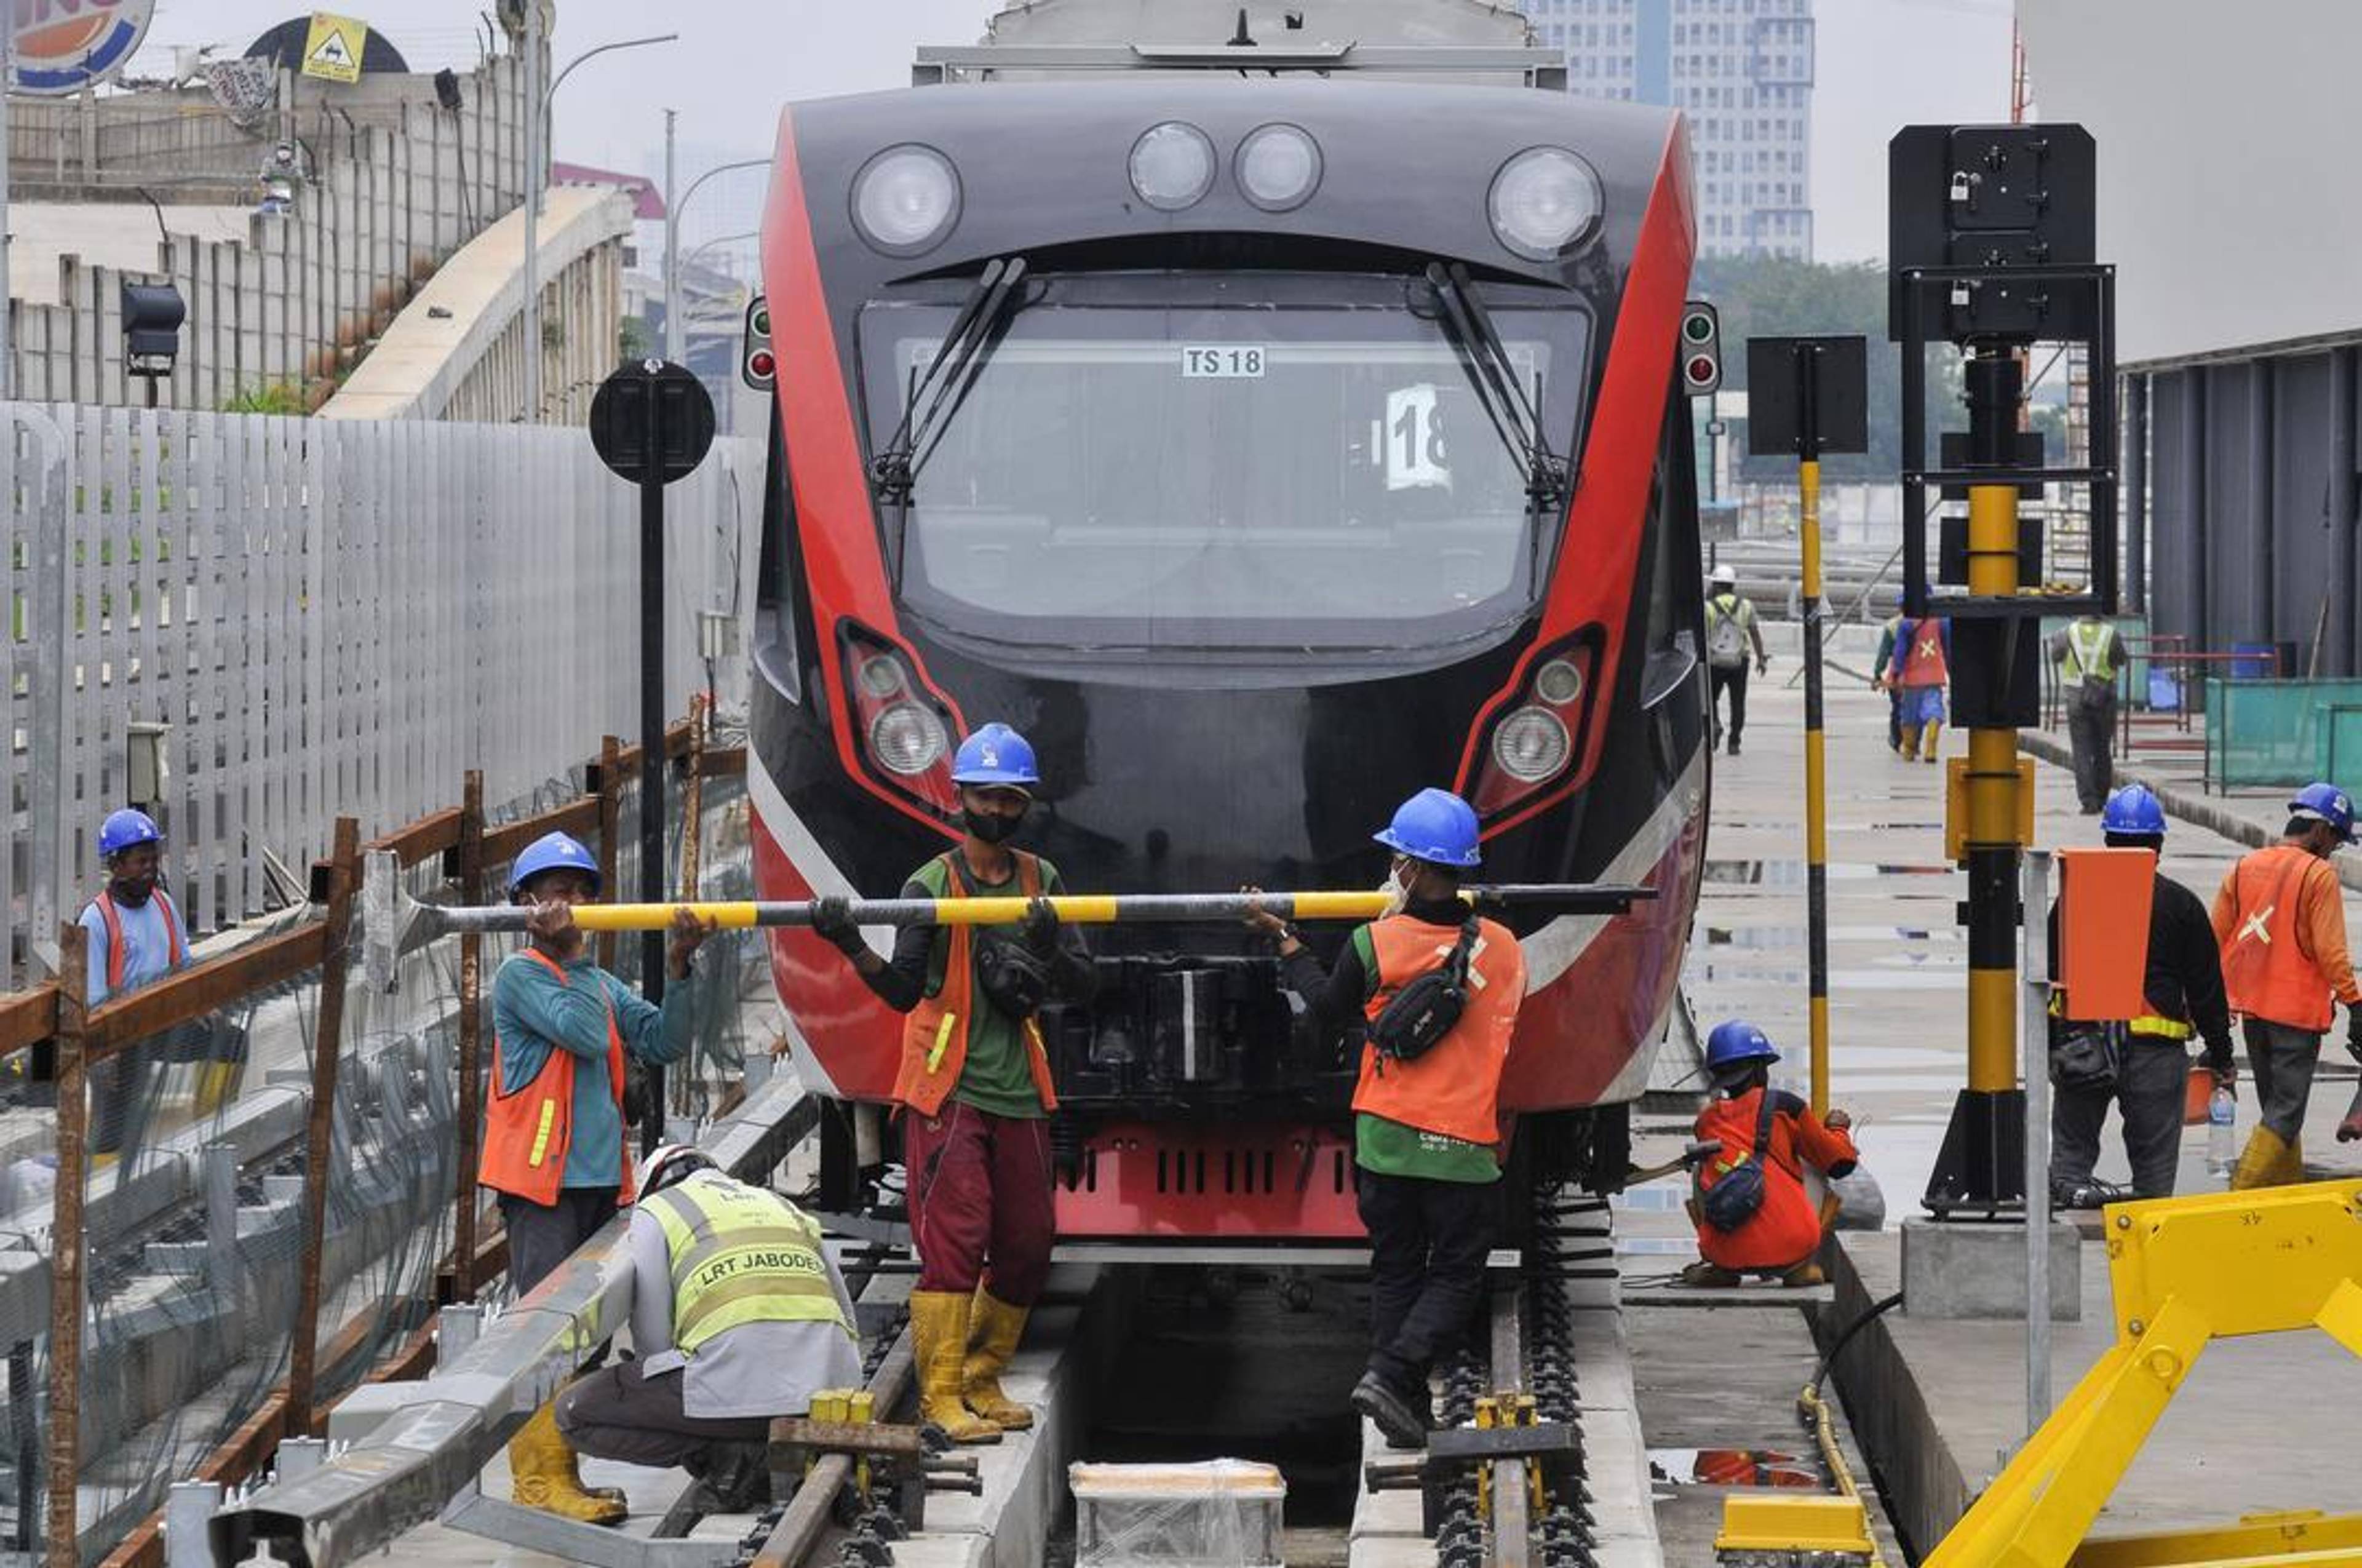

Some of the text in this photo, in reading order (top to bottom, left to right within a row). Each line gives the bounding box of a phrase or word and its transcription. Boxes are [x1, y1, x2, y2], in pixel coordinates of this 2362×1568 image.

[1187, 349, 1260, 373] TS 18
[701, 1257, 736, 1285] LRT
